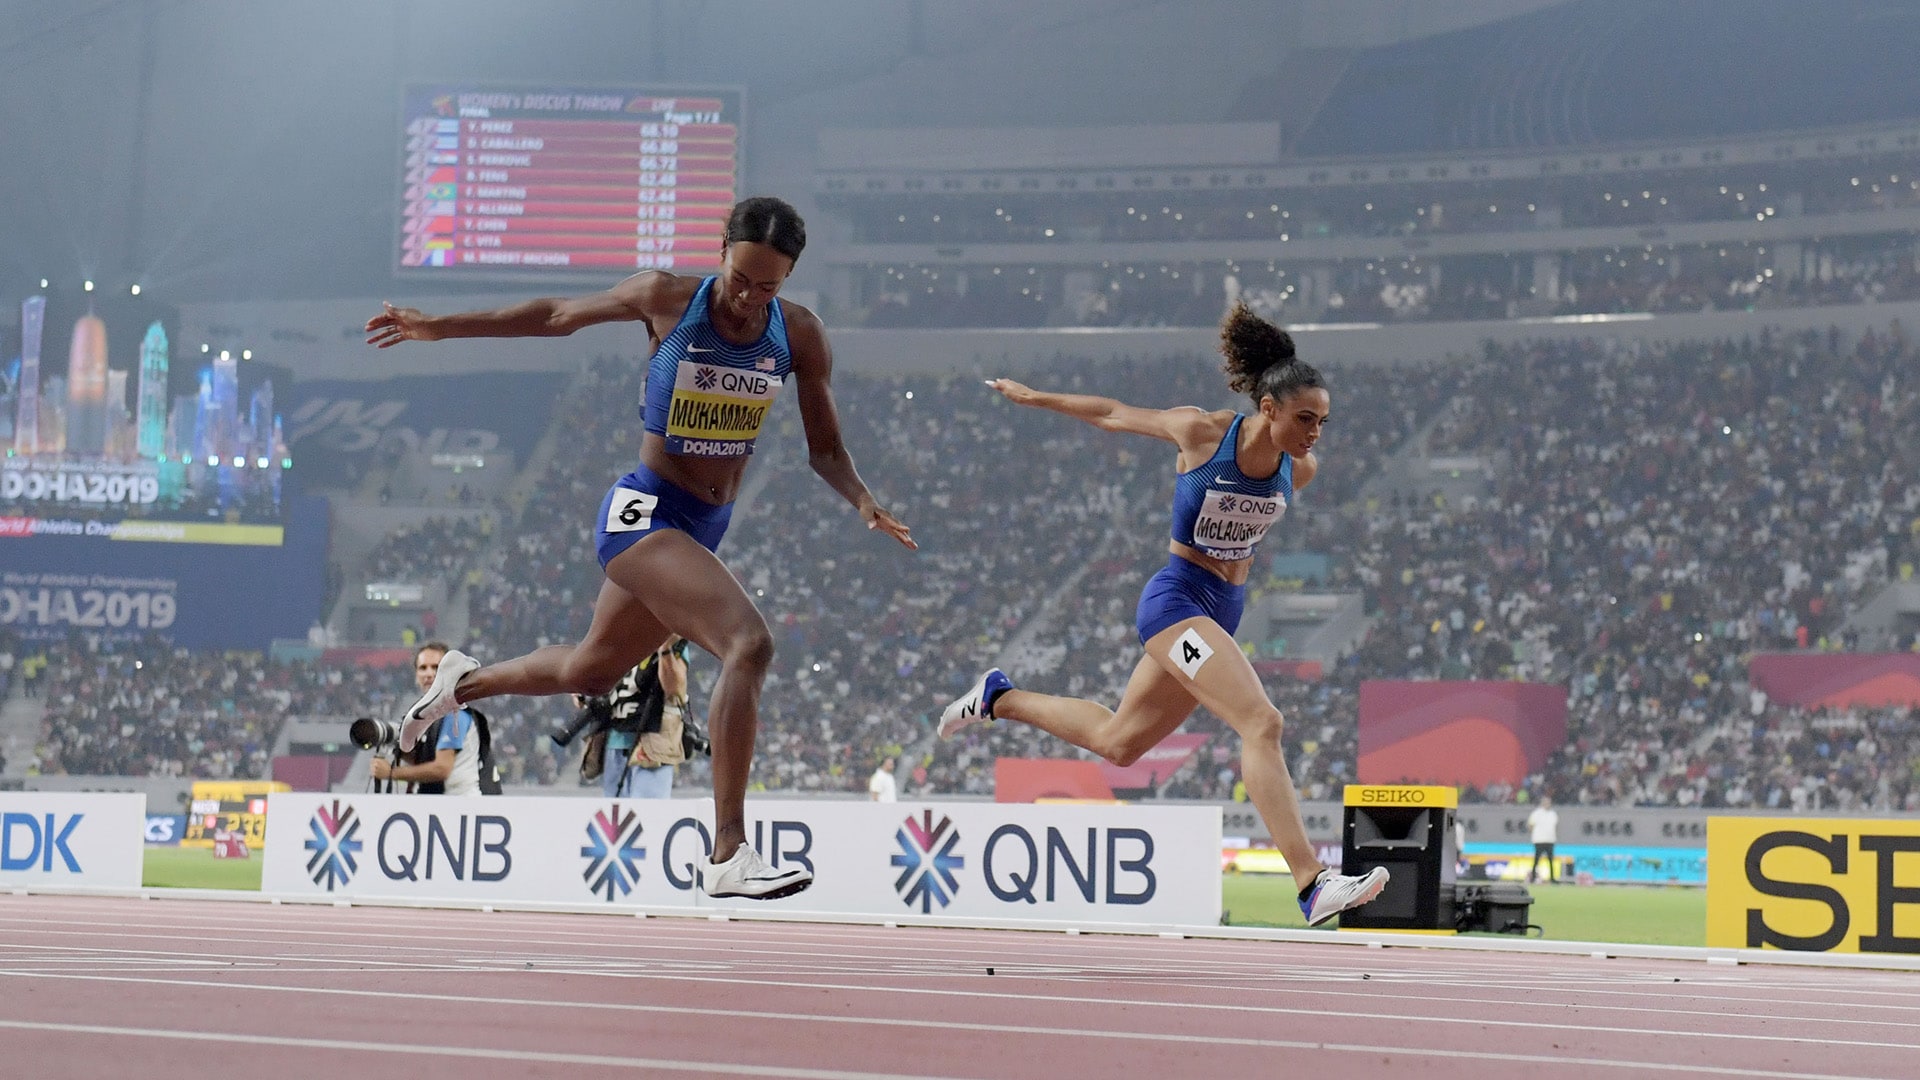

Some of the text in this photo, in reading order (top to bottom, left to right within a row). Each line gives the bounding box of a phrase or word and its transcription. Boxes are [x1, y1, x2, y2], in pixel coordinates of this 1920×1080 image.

[459, 107, 491, 119] FINAL
[523, 95, 572, 110] DISCUS
[574, 97, 625, 112] THROW
[480, 120, 514, 133] PEREZ
[663, 111, 694, 127] Page
[480, 136, 545, 151] CABALLERO
[478, 170, 509, 183] FENG
[477, 203, 525, 216] ALLMAN
[476, 218, 508, 232] CHEN
[476, 235, 502, 248] VITA
[721, 373, 768, 395] QNB
[671, 398, 766, 431] MUHAMMAD
[683, 440, 746, 456] DOHA2019
[1, 471, 159, 504] DOHA2019
[618, 499, 644, 526] 6
[1240, 499, 1277, 515] QNB
[29, 518, 84, 536] Athletics
[85, 520, 185, 540] Championships
[1182, 640, 1201, 664] 4
[1361, 789, 1425, 803] SEIKO
[143, 817, 175, 842] CS
[0, 811, 84, 873] DK
[377, 812, 512, 882] QNB
[662, 817, 815, 891] QB
[983, 823, 1157, 905] QNB
[1744, 830, 1920, 952] SE
